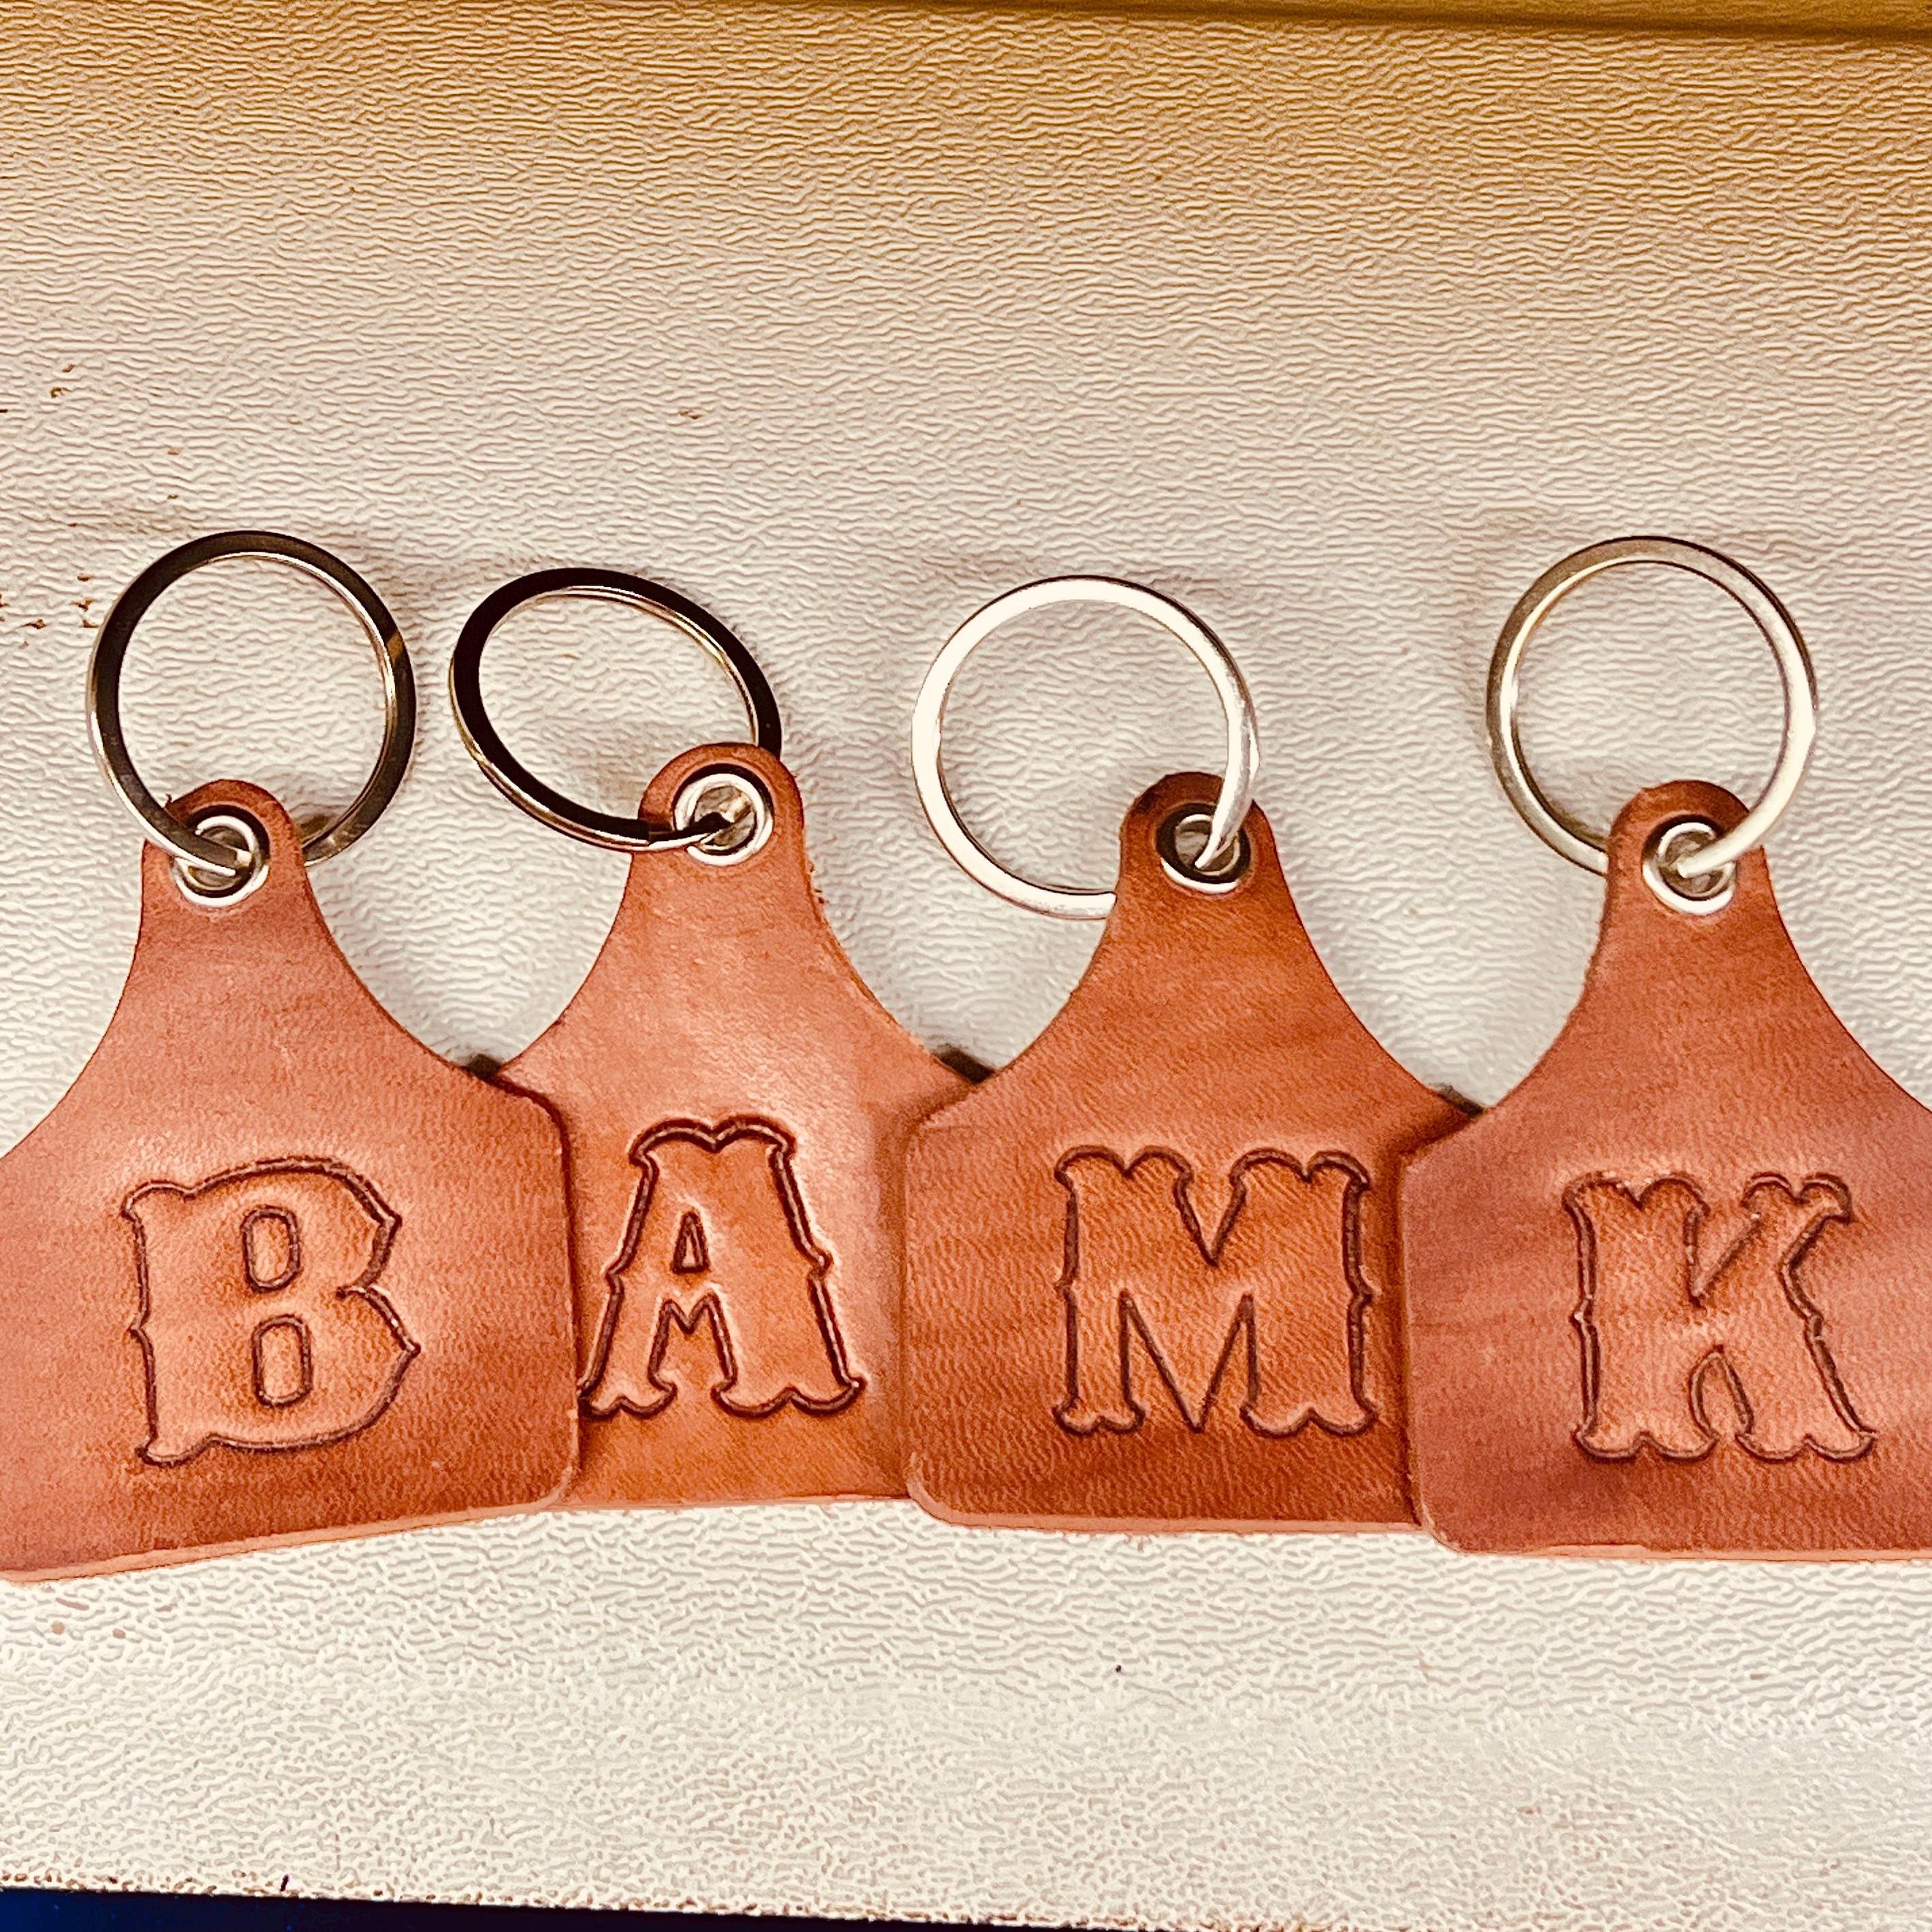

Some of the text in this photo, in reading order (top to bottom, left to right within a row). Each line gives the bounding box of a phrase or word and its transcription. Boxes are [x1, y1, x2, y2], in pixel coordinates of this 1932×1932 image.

[121, 1156, 422, 1466] B
[582, 1115, 868, 1418] A
[1055, 1147, 1376, 1436] M
[1564, 1171, 1877, 1461] K
